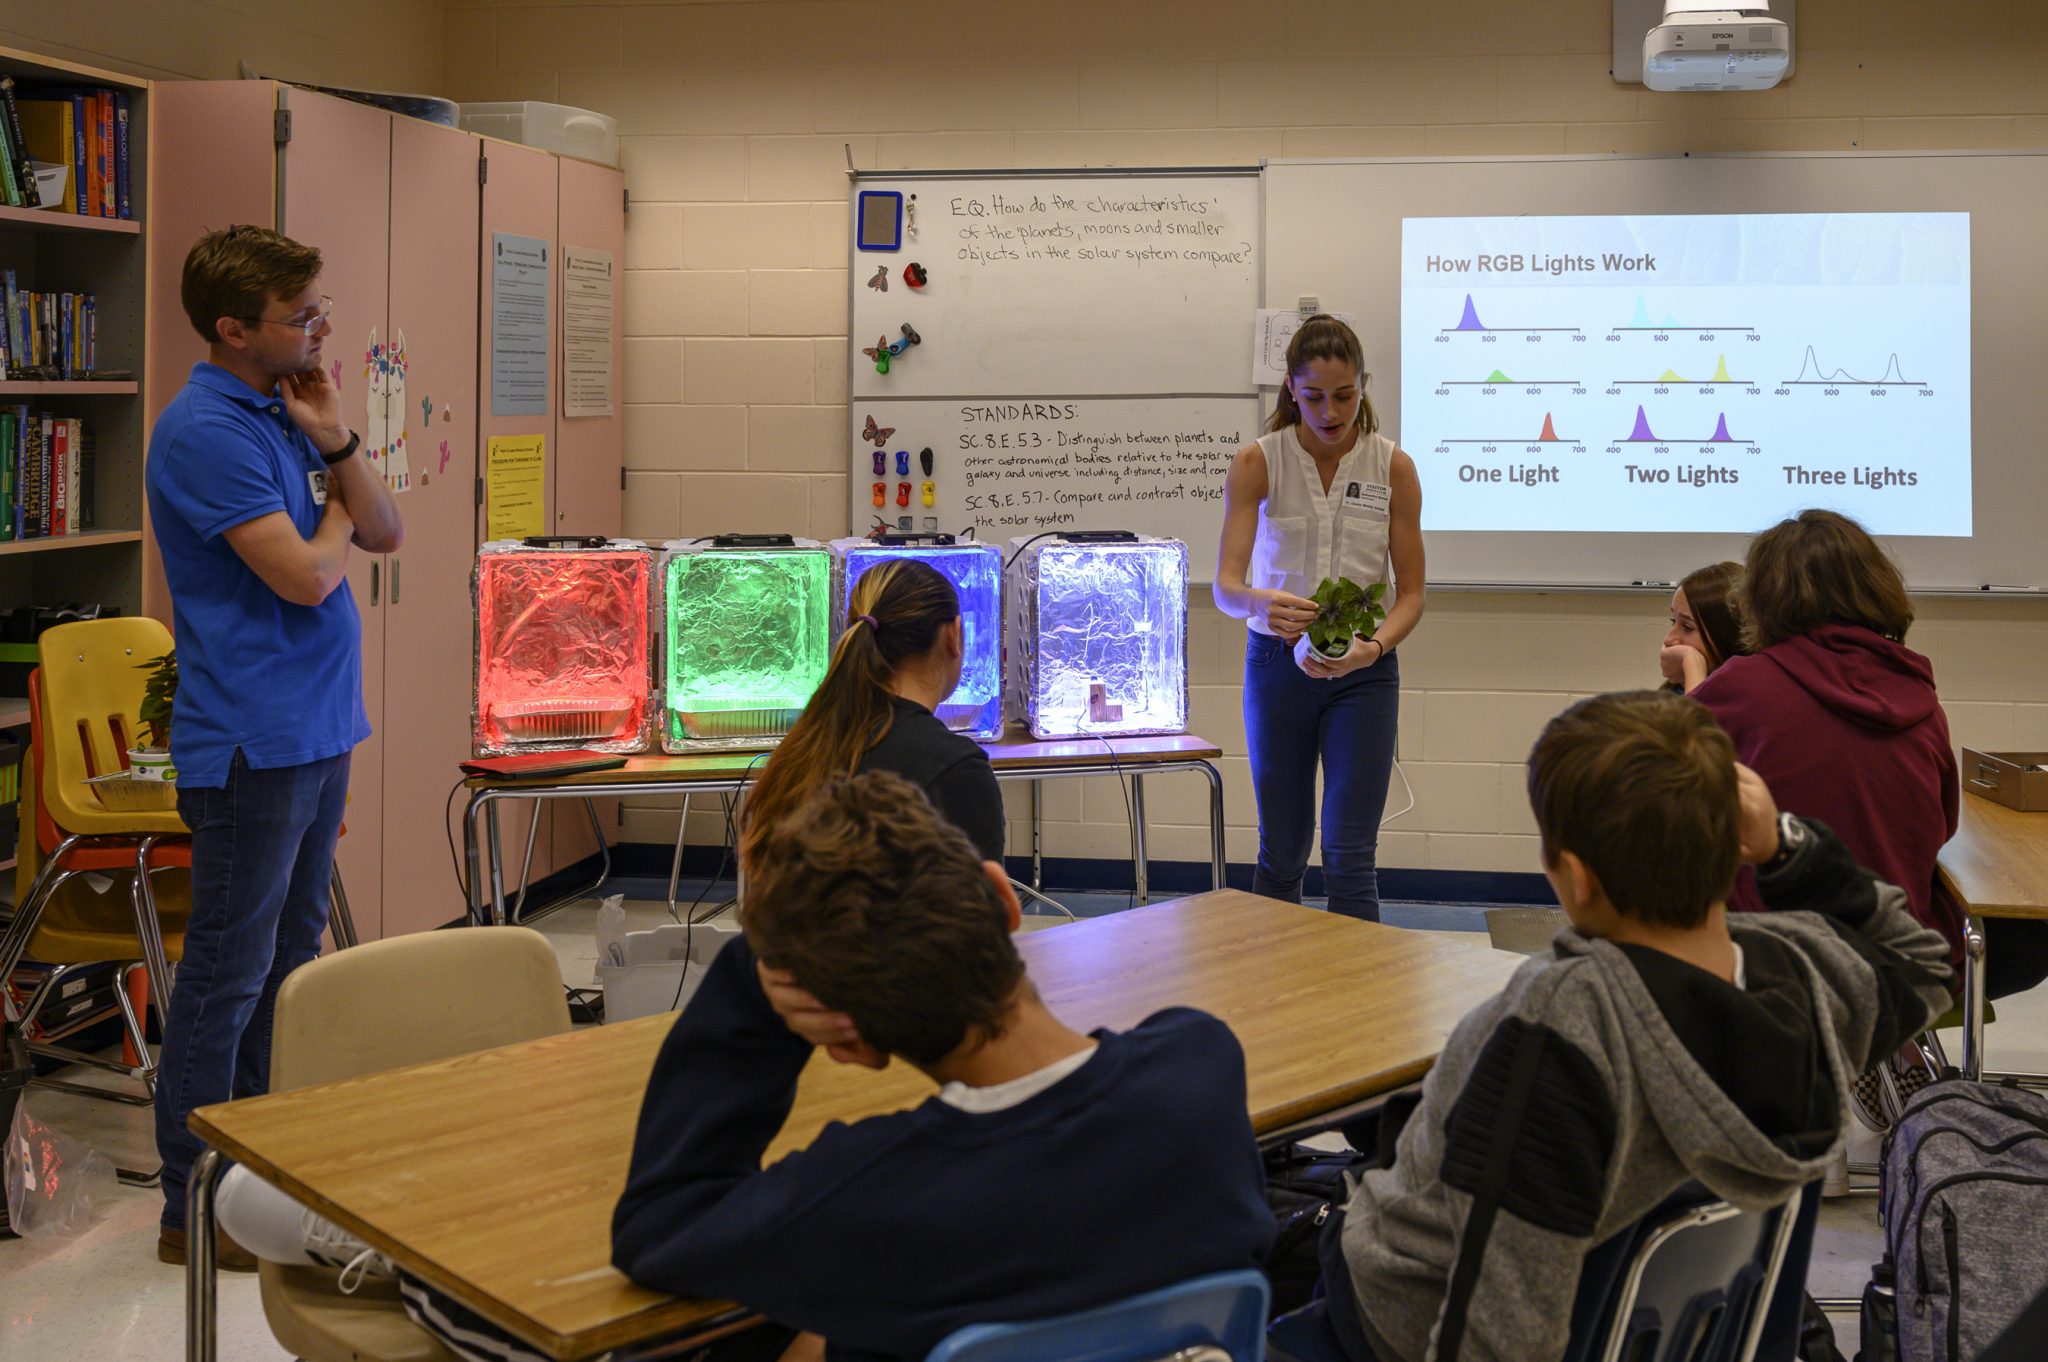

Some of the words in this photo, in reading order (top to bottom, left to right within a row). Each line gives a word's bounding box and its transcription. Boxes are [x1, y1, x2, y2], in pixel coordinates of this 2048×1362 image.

[120, 122, 128, 162] BIOLOGY
[992, 194, 1024, 215] How
[1029, 196, 1047, 213] do
[1051, 194, 1078, 211] the
[1087, 194, 1209, 214] characteristics
[958, 224, 980, 240] of
[985, 225, 1015, 240] the
[1018, 222, 1082, 245] planets,
[1083, 223, 1131, 235] moons
[1134, 219, 1162, 235] and
[1167, 220, 1224, 236] smaller
[957, 244, 1020, 266] objects
[1026, 247, 1041, 260] in
[1047, 245, 1072, 260] the
[1077, 246, 1121, 260] solar
[1125, 245, 1179, 268] system
[1183, 242, 1252, 269] compare?
[1426, 255, 1471, 273] How
[1477, 254, 1525, 273] RGB
[1531, 253, 1596, 276] Lights
[1601, 253, 1657, 272] Work
[1434, 335, 1450, 343] 400
[1481, 335, 1497, 343] 500
[1525, 335, 1542, 343] 600
[1571, 334, 1587, 343] 700
[1605, 334, 1621, 343] 400
[1653, 334, 1670, 342] 500
[1698, 334, 1715, 342] 600
[1745, 334, 1761, 342] 700
[1434, 388, 1450, 396] 400
[1481, 387, 1497, 396] 500
[1526, 387, 1542, 396] 600
[1571, 387, 1587, 395] 700
[1605, 388, 1621, 396] 400
[1653, 387, 1670, 395] 500
[1698, 387, 1715, 395] 600
[1745, 387, 1761, 395] 700
[1774, 388, 1791, 396] 400
[1823, 388, 1840, 396] 500
[1870, 389, 1887, 397] 600
[1918, 389, 1934, 397] 700
[961, 403, 1079, 422] STANDARDS:
[1057, 430, 1122, 453] Distinguish
[1126, 430, 1170, 444] between
[1175, 430, 1214, 447] planets
[1220, 431, 1240, 444] and
[1434, 446, 1450, 454] 400
[1481, 445, 1497, 453] 500
[1526, 445, 1542, 454] 600
[1571, 446, 1587, 454] 700
[1605, 446, 1622, 454] 400
[1654, 446, 1670, 454] 500
[1699, 446, 1715, 455] 600
[1745, 447, 1761, 455] 700
[964, 456, 994, 467] other
[998, 454, 1069, 466] astronomical
[1075, 452, 1112, 463] bodies
[1117, 451, 1157, 463] relative
[1160, 452, 1172, 462] to
[1176, 450, 1193, 461] the
[1195, 451, 1221, 461] solar
[30, 427, 41, 518] CAMBRIDGE
[966, 469, 1000, 487] galaxy
[1005, 468, 1025, 478] and
[1029, 469, 1071, 479] universe
[1075, 467, 1121, 485] including
[1123, 466, 1165, 478] distance,
[1168, 465, 1187, 475] size
[1190, 461, 1207, 478] and
[1458, 464, 1502, 483] One
[1509, 463, 1560, 487] Light
[1624, 465, 1670, 484] Two
[1677, 464, 1739, 488] Lights
[1782, 465, 1847, 485] Three
[1853, 467, 1918, 489] Lights
[57, 483, 65, 509] BIG
[1054, 490, 1104, 508] Compare
[1108, 486, 1132, 501] and
[1136, 483, 1184, 500] contrast
[1191, 486, 1225, 501] object
[975, 515, 996, 527] the
[1000, 514, 1029, 525] solar
[1034, 512, 1074, 528] system
